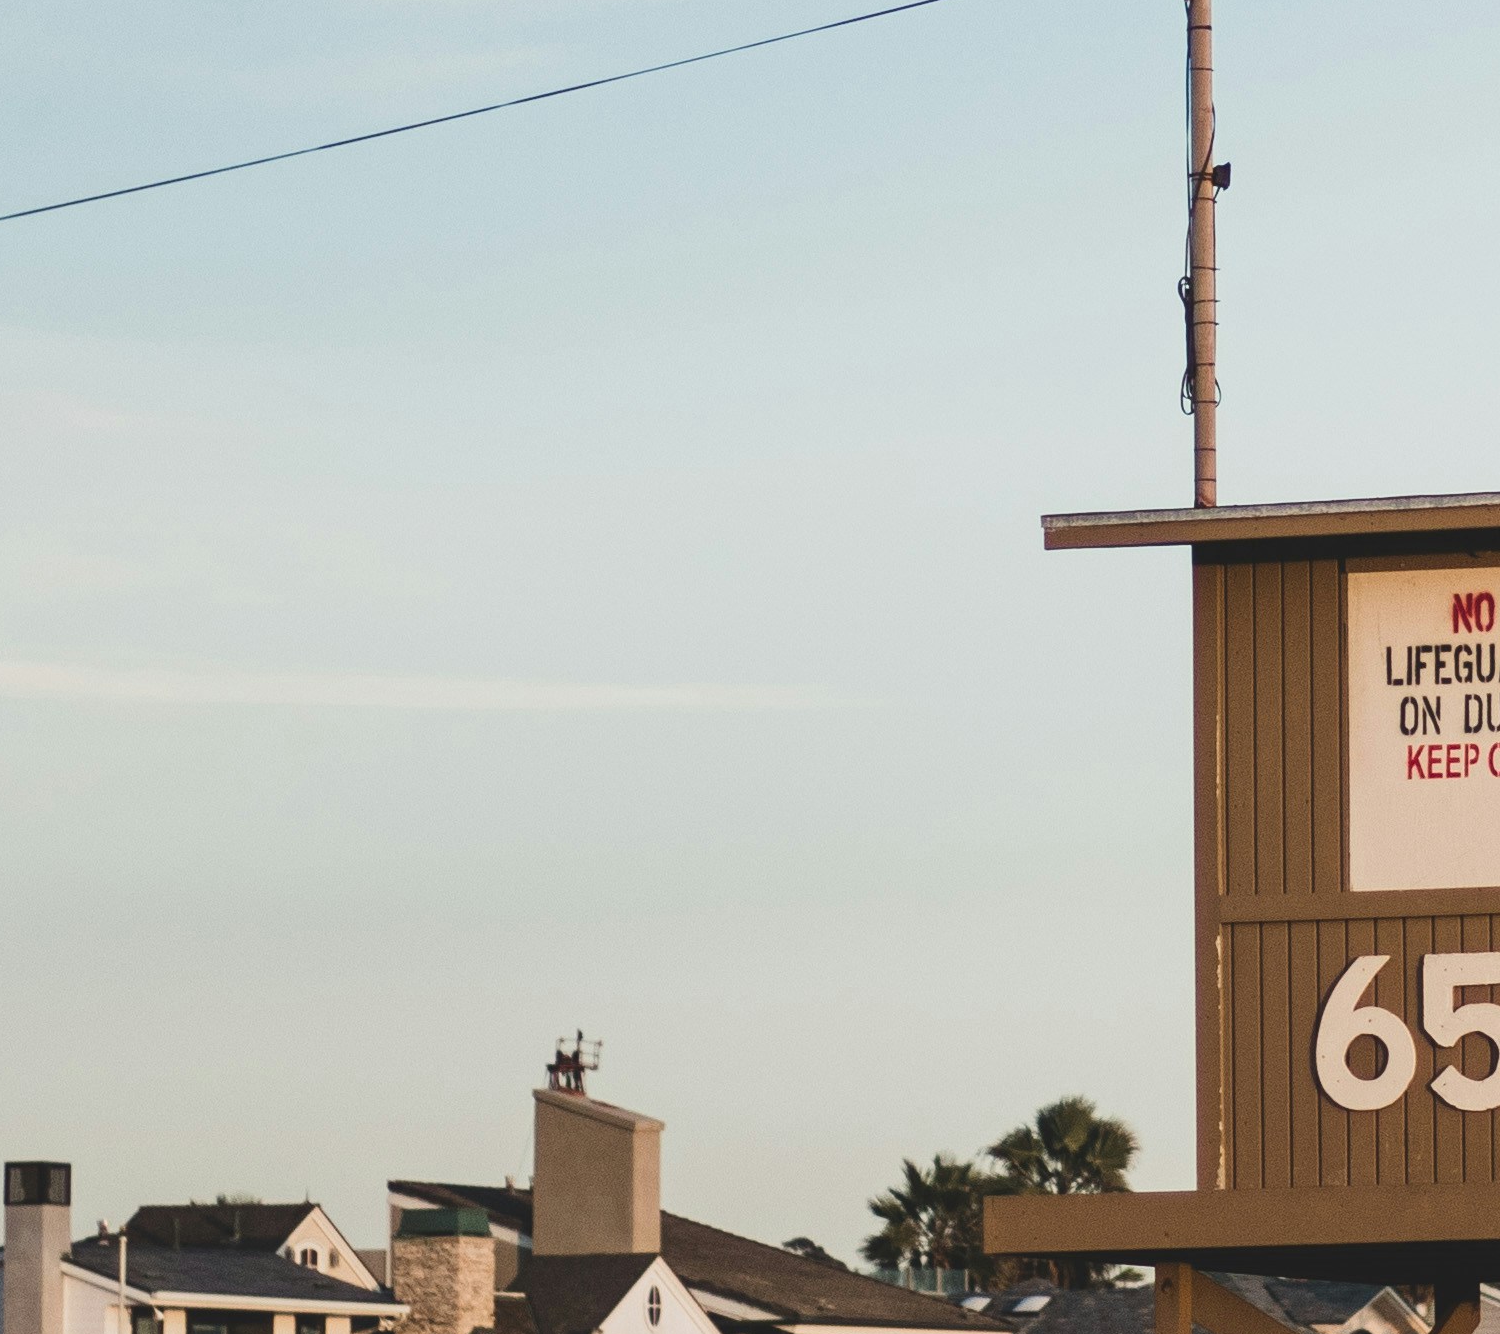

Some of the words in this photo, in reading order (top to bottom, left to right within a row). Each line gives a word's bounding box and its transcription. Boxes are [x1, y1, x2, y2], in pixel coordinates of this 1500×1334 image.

[1452, 591, 1496, 634] NO
[1400, 695, 1441, 736] ON
[1407, 743, 1480, 780] KEEP
